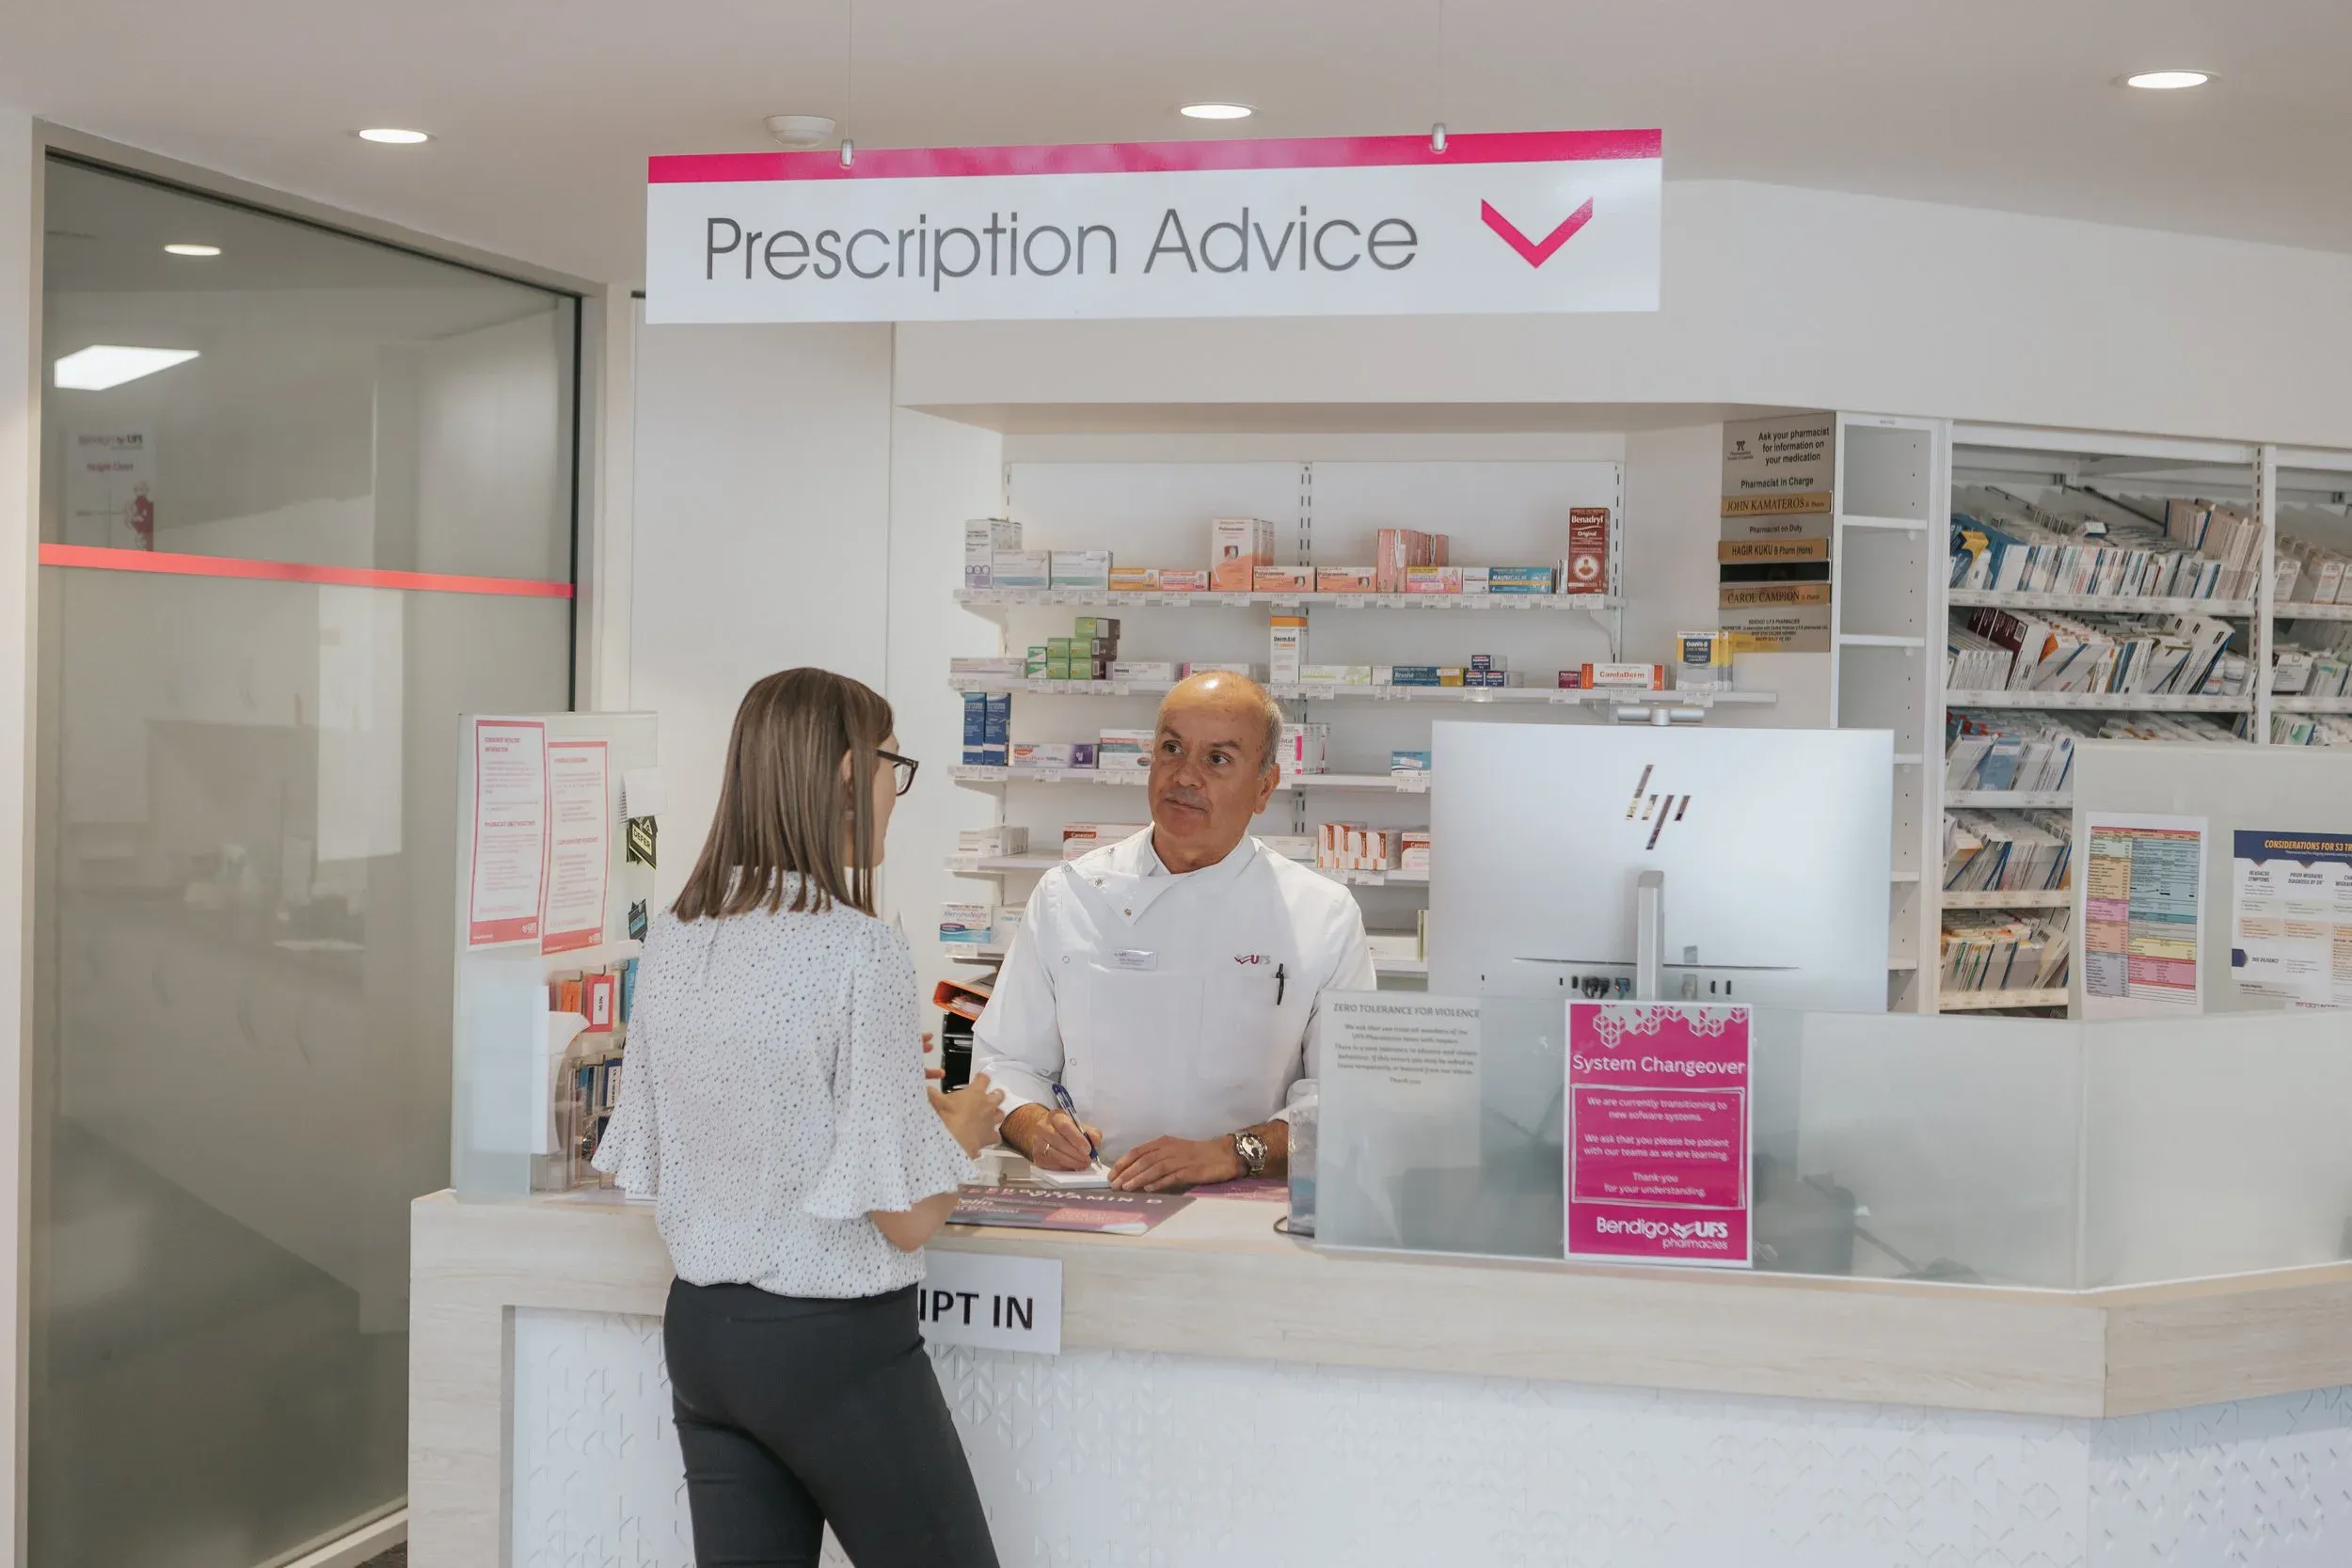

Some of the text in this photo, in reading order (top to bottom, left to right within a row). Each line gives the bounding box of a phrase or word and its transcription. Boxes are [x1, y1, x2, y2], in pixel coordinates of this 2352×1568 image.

[705, 206, 1418, 293] Prescription Advice
[1758, 427, 1830, 442] Ask your pharmacist
[1774, 442, 1814, 451] information
[1766, 452, 1821, 467] your medication
[1740, 477, 1814, 488] Pharmacist in Charge
[1726, 500, 1750, 511] JOHN
[1751, 496, 1804, 510] KAMATEROS
[1571, 515, 1604, 526] Benadryl
[1749, 526, 1780, 534] Pharmacist
[1789, 524, 1803, 533] Duty
[1732, 546, 1753, 556] HAGIR
[1754, 545, 1773, 555] KUKU
[1779, 546, 1796, 554] Pharm
[1728, 594, 1757, 604] CAROL
[1759, 591, 1800, 602] CAMPION
[633, 829, 650, 849] DEFER
[2265, 840, 2320, 850] CONSIDERATIONS
[1250, 955, 1271, 965] UFS
[1333, 1003, 1480, 1018] ZERO TOLERANCE FOR VIOLENCE
[1572, 1054, 1746, 1077] System Changeover
[1587, 1097, 1600, 1106] We
[1618, 1098, 1659, 1110] currently
[1661, 1099, 1716, 1112] transitioning
[1717, 1101, 1728, 1110] to
[1609, 1111, 1628, 1119] new
[1664, 1113, 1704, 1122] systems.
[1584, 1133, 1730, 1148] We ask that you please be patient
[1583, 1148, 1603, 1156] with
[1622, 1148, 1648, 1158] teams
[1661, 1150, 1675, 1159] we
[1676, 1150, 1692, 1159] are
[1692, 1150, 1729, 1163] learning.
[1604, 1184, 1707, 1198] for your understanding.
[1597, 1216, 1728, 1240] Bendigo UFS
[1661, 1238, 1728, 1250] pharmacies
[919, 1289, 1033, 1330] IPT IN
